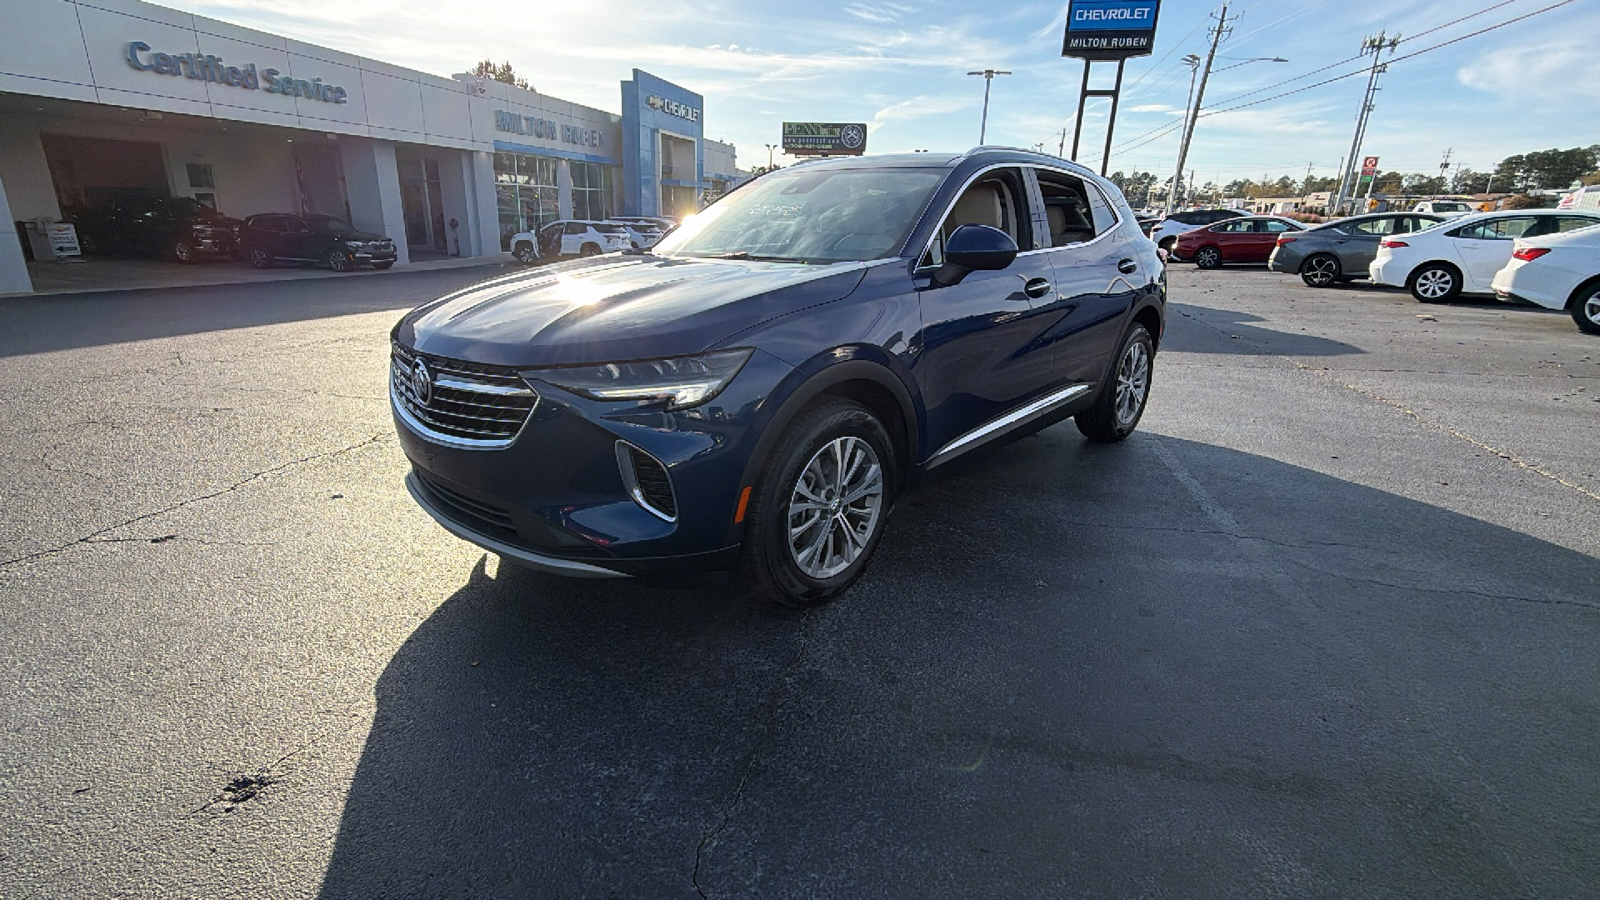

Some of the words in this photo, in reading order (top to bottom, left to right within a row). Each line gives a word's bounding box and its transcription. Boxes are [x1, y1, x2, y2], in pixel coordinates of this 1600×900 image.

[1075, 8, 1151, 21] CHEVROLET
[1069, 38, 1107, 48] MILTON
[1111, 37, 1147, 48] RUBEN
[126, 41, 260, 90] Certified
[262, 68, 348, 104] Service
[663, 97, 701, 122] CHEVROLET
[495, 109, 557, 141] MILTON
[562, 124, 605, 149] RUBEN
